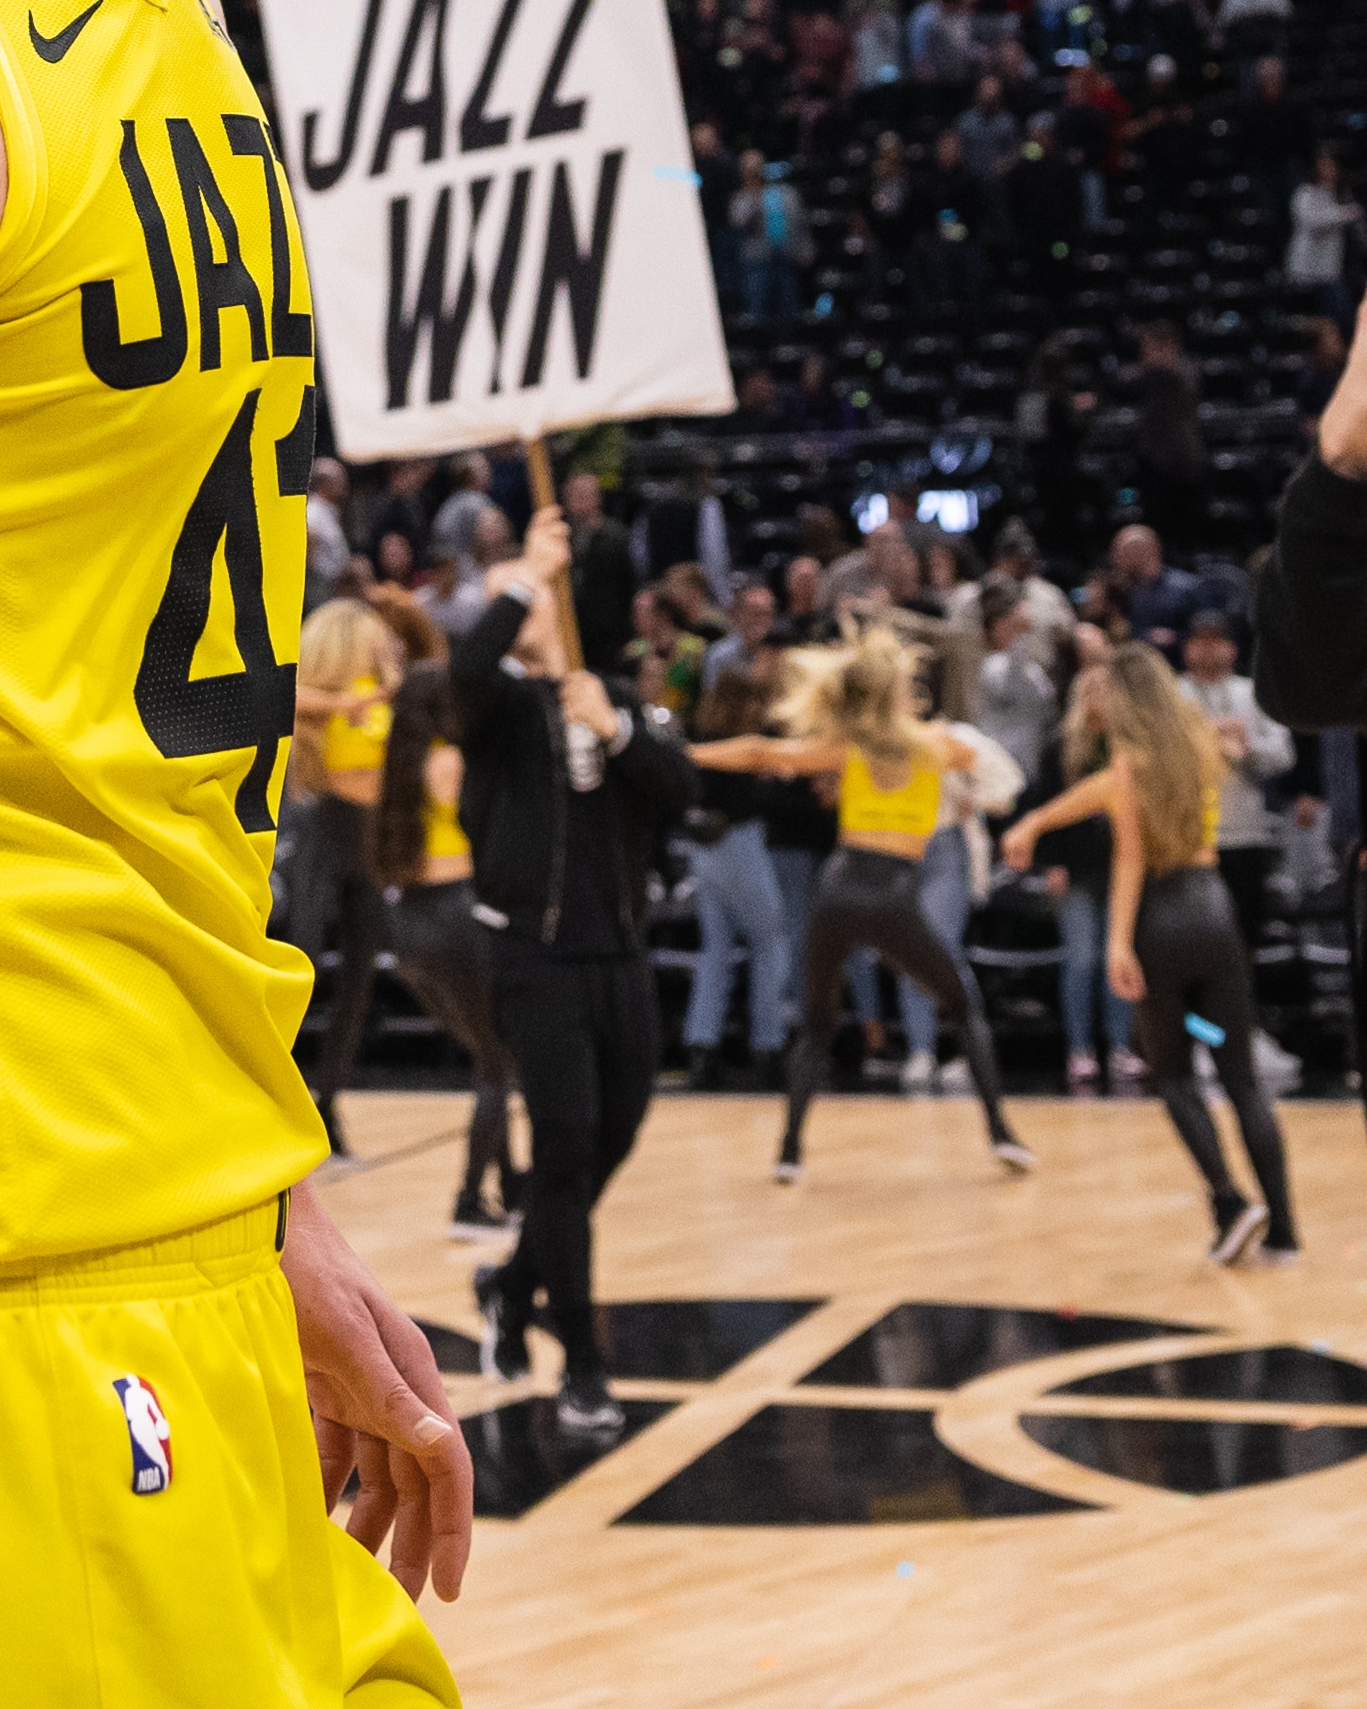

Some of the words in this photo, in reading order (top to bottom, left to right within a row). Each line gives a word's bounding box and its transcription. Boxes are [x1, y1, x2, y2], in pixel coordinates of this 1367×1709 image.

[81, 114, 314, 391] JAZ
[383, 148, 628, 412] WIN
[136, 1465, 161, 1492] NBA
